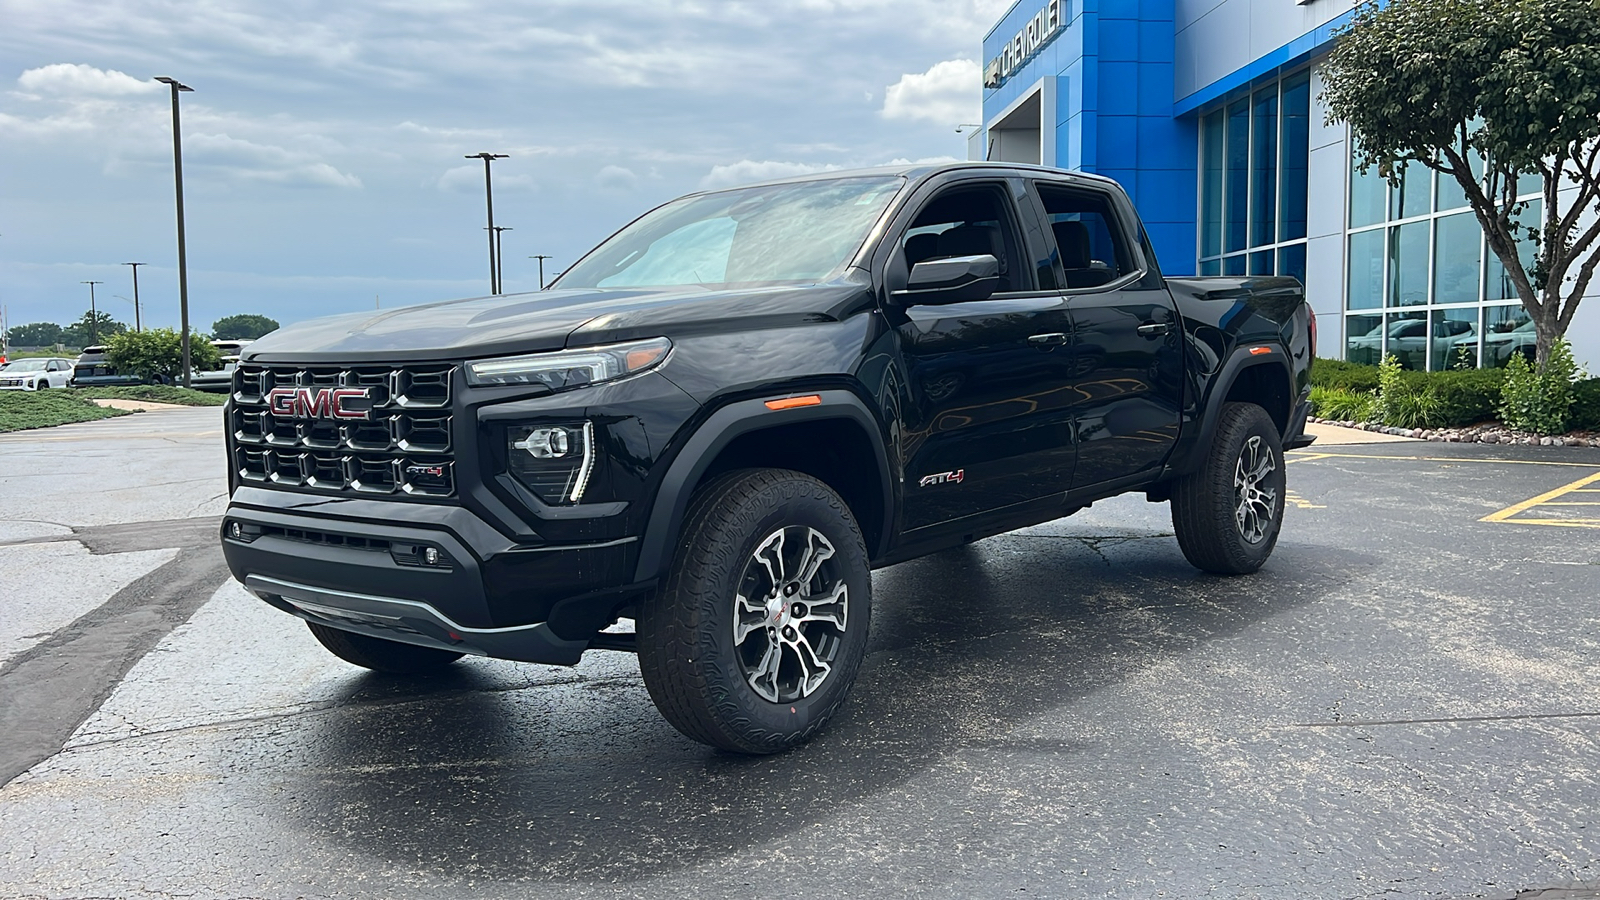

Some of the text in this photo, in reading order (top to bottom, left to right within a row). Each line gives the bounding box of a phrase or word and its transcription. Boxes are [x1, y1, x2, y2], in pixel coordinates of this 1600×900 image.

[1002, 0, 1064, 78] CHEVROLET
[270, 388, 370, 420] GMC
[406, 465, 442, 477] AT4
[919, 469, 964, 487] AT4
